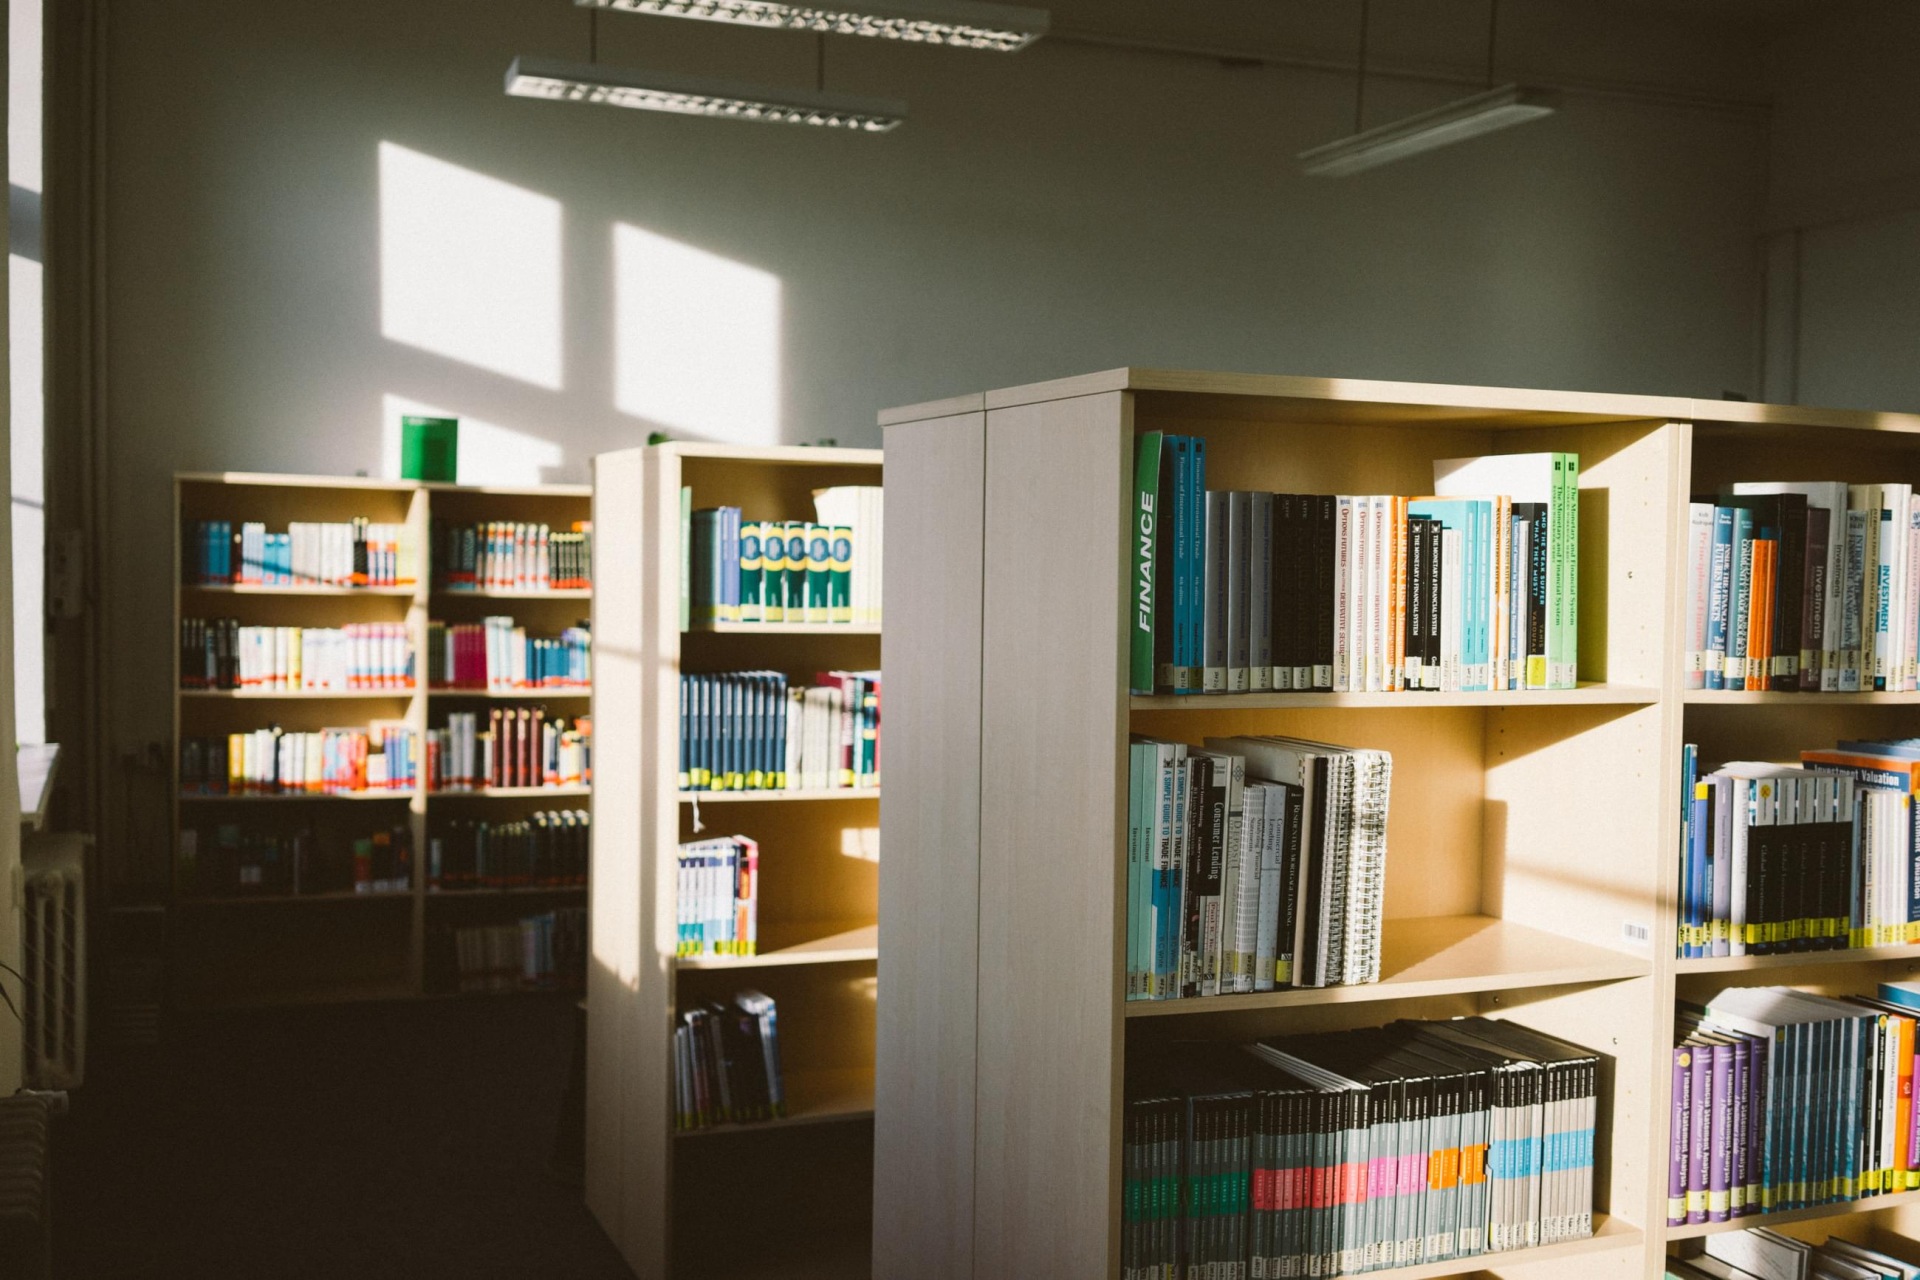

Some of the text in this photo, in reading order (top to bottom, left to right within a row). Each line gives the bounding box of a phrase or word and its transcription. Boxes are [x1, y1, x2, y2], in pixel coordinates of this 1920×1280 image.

[1139, 491, 1154, 633] FINANCE
[1834, 544, 1843, 598] Investments
[1711, 543, 1724, 621] FUTURES MARKETS
[1881, 565, 1890, 633] INVESTMENT
[1813, 565, 1824, 639] Investments
[1163, 777, 1171, 802] SIMPLE
[1176, 776, 1184, 801] SIMPLE
[1861, 770, 1900, 787] Valuation
[1161, 837, 1169, 859] TRADE
[1162, 826, 1169, 835] TO
[1174, 836, 1182, 858] TRADE
[1175, 826, 1182, 834] TO
[1208, 802, 1224, 880] Consumer Lending
[1230, 820, 1242, 870] DEPOSIT
[1266, 818, 1275, 851] Lending
[1275, 818, 1283, 865] Commercial
[1160, 861, 1168, 889] FINANCE
[1173, 860, 1181, 888] FINANCE
[1682, 1072, 1690, 1109] Financial
[1726, 1069, 1734, 1106] Financial
[1702, 1110, 1710, 1150] Statement
[1725, 1109, 1733, 1148] Statement
[1738, 1066, 1749, 1180] Financial Statement Analysis
